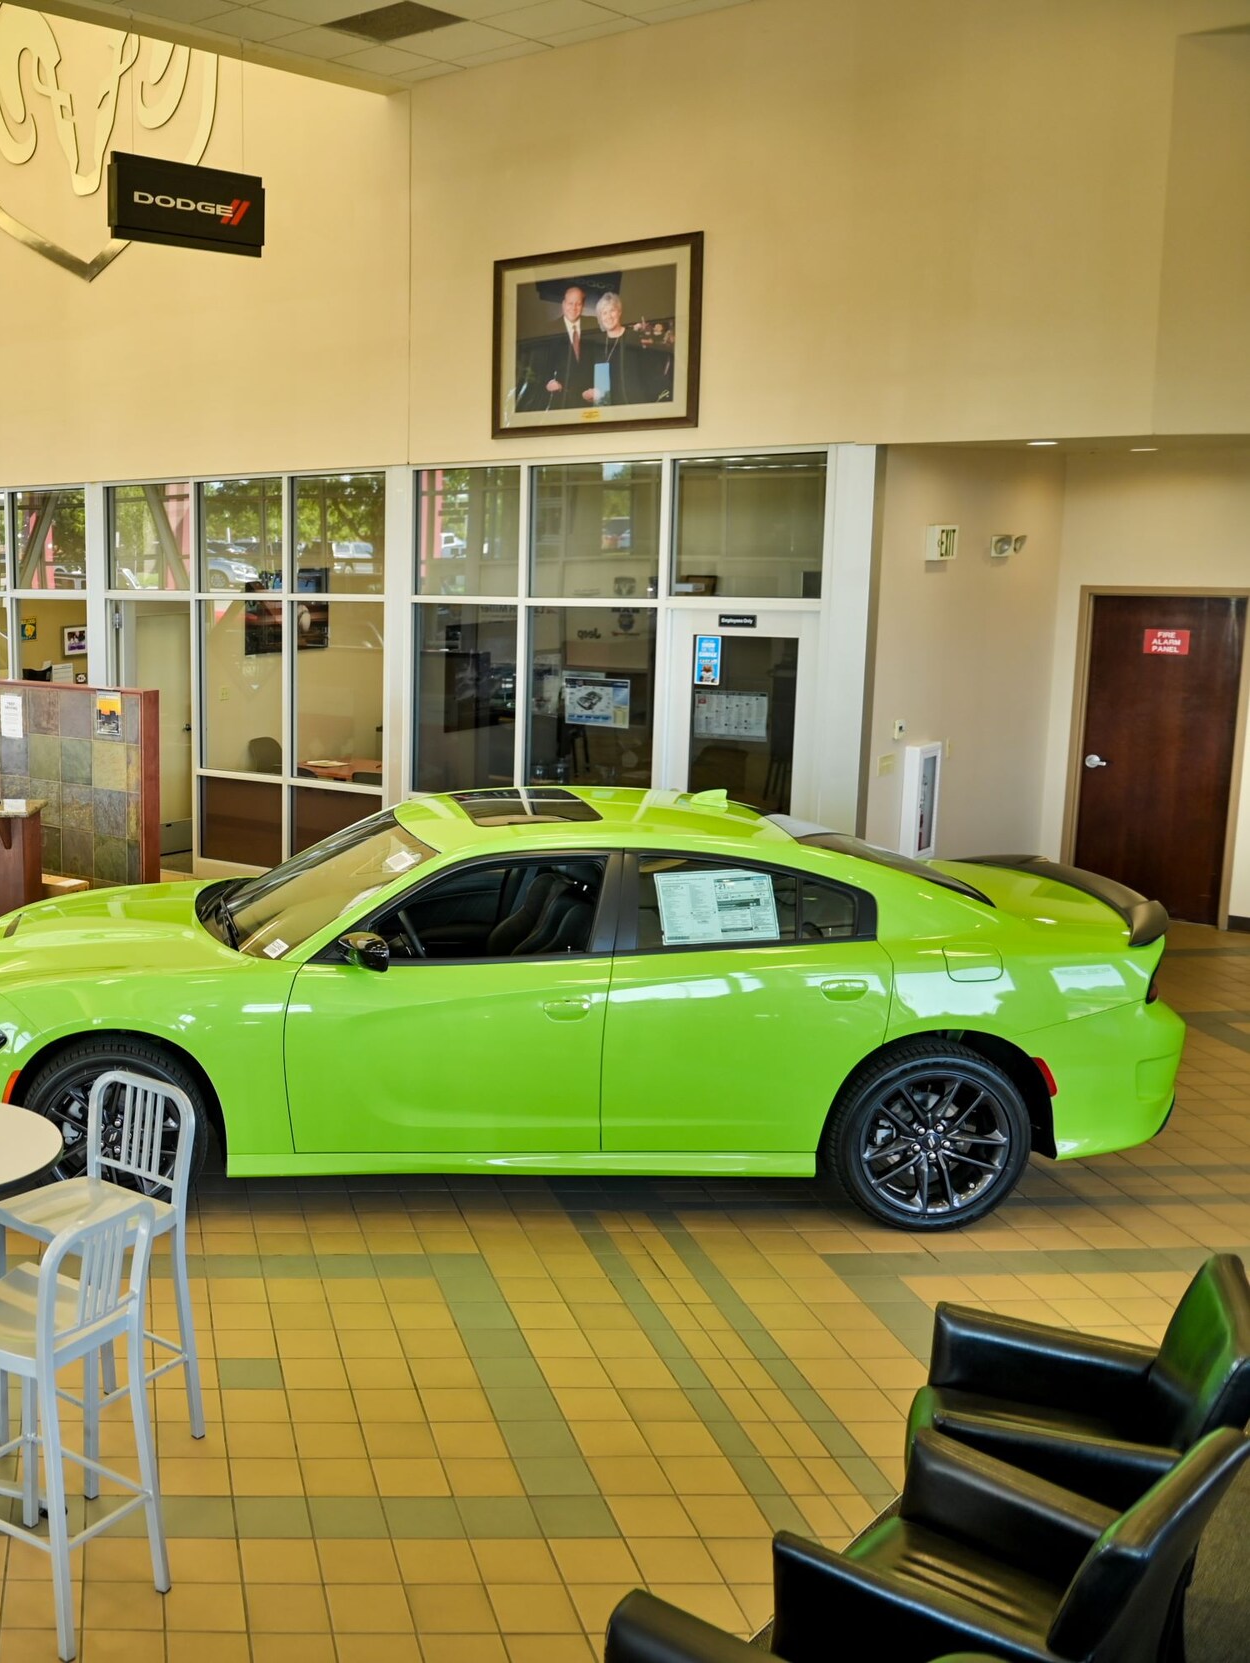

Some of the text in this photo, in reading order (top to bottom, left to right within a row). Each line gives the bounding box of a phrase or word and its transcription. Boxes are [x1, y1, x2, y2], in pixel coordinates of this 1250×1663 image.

[133, 191, 233, 217] DODGE
[940, 529, 956, 557] EXIT
[1151, 645, 1179, 653] PANEL
[1152, 638, 1181, 646] ALARM
